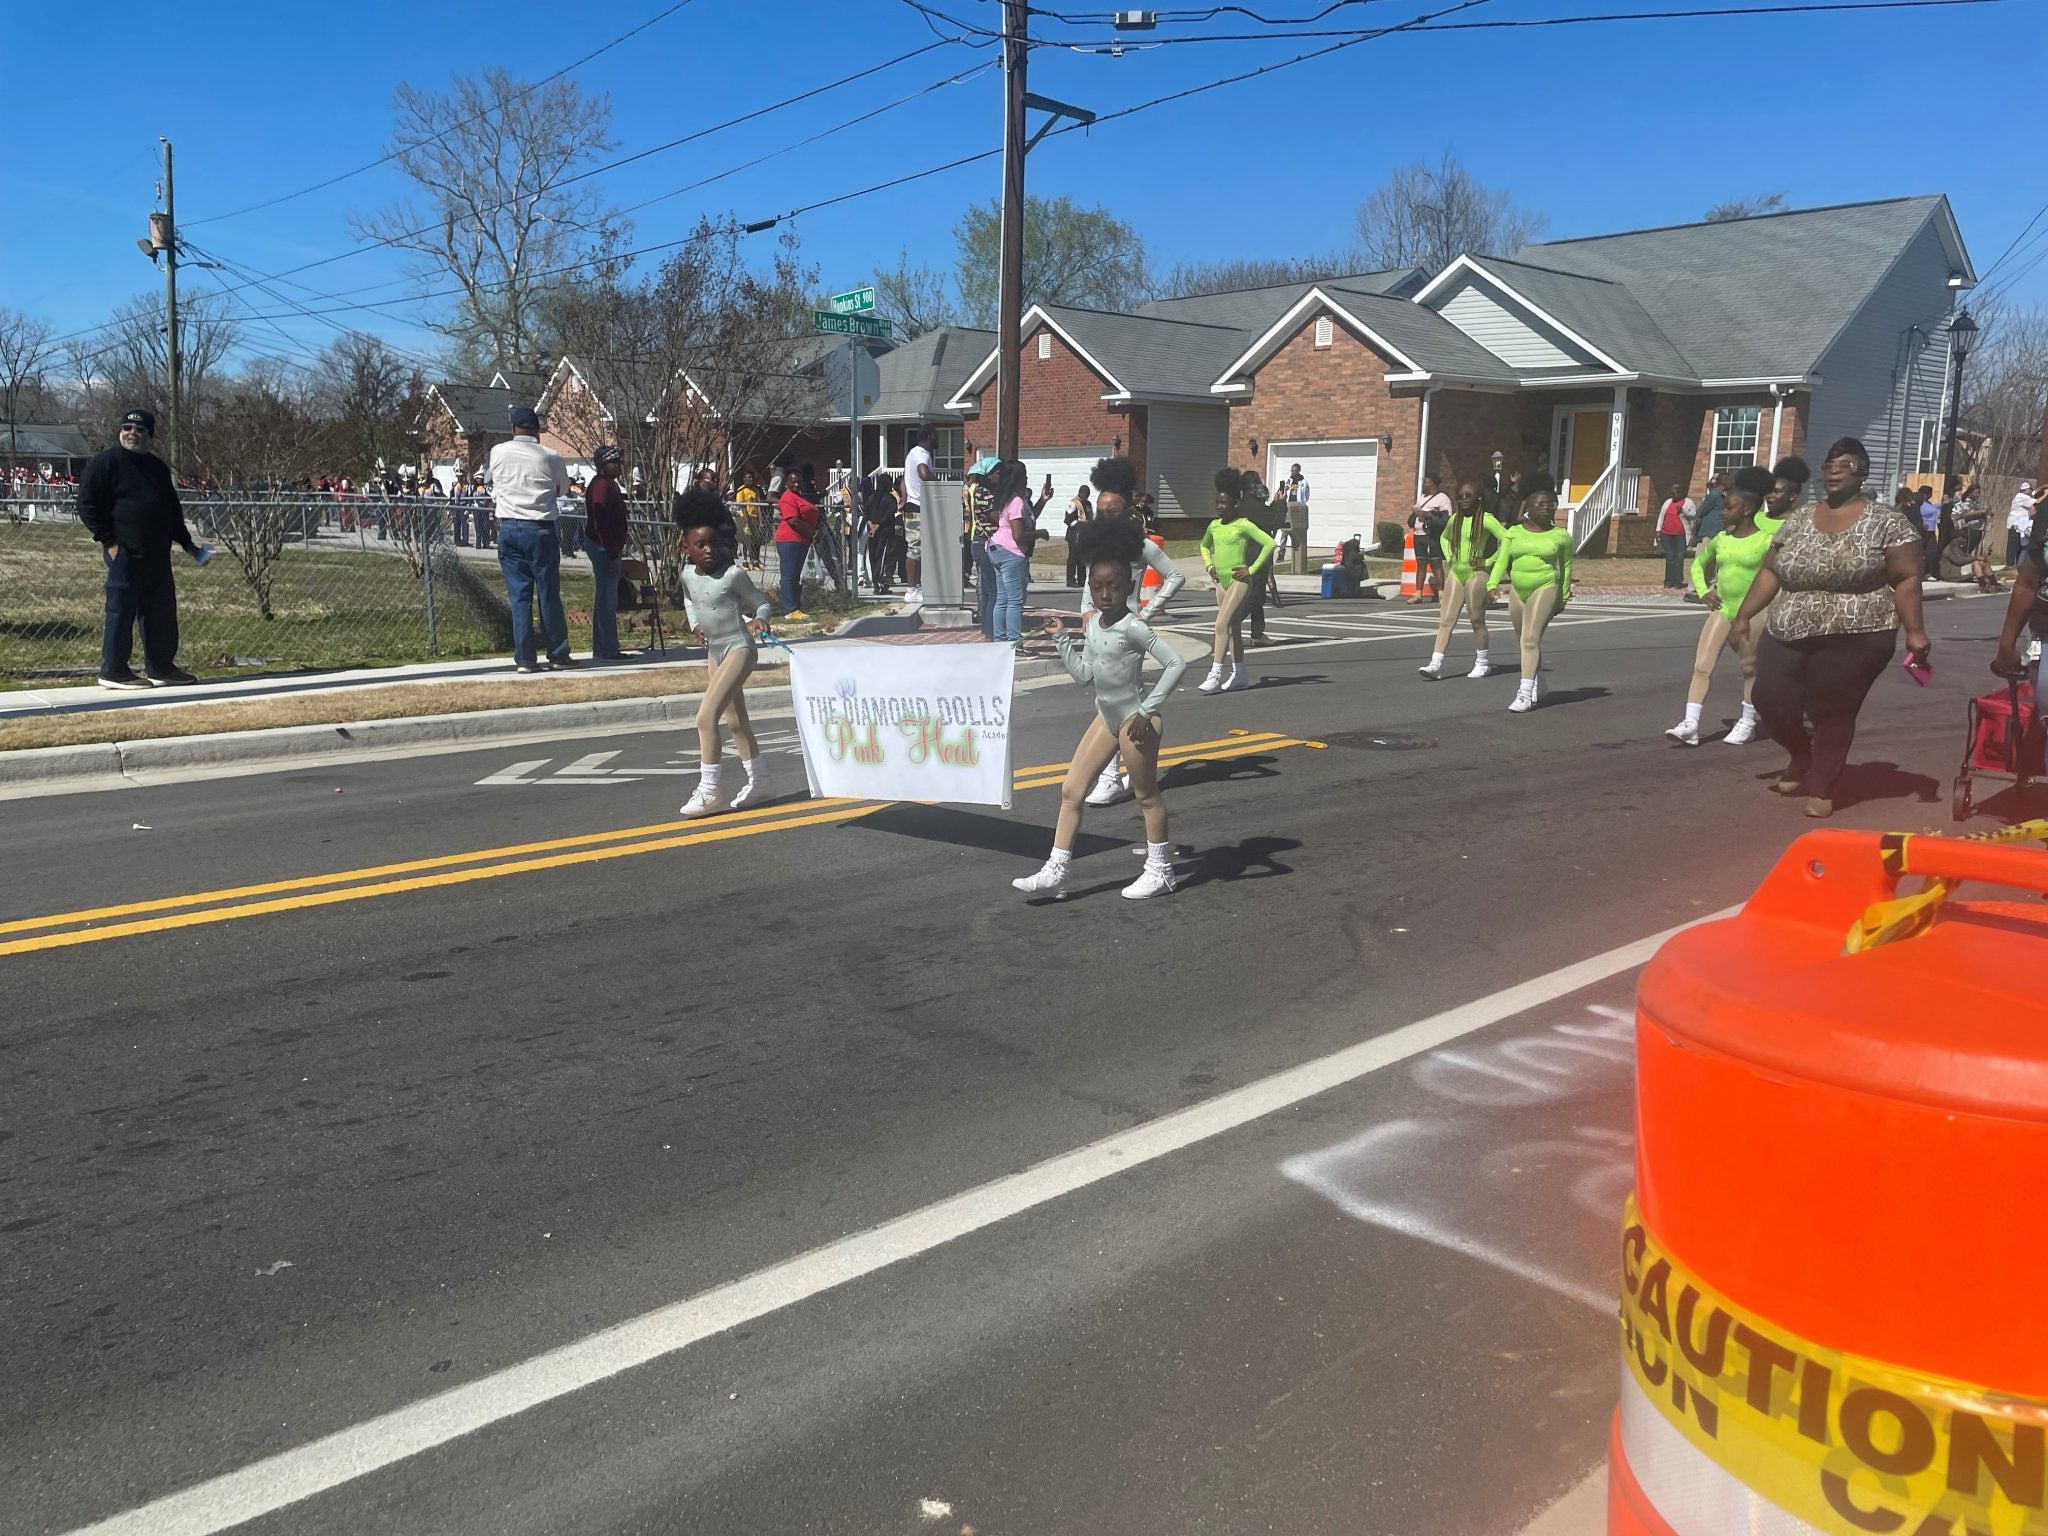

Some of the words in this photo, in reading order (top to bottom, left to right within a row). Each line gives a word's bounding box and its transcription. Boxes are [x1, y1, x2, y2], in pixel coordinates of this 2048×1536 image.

[817, 312, 848, 330] James
[850, 317, 878, 335] Brown
[1612, 414, 1620, 451] 905
[806, 697, 838, 724] THE
[843, 697, 930, 726] DIAMOND
[937, 695, 1005, 726] DOLLS
[825, 717, 884, 763] Pink
[900, 717, 980, 766] Heat
[1623, 1224, 2045, 1509] CAUTION
